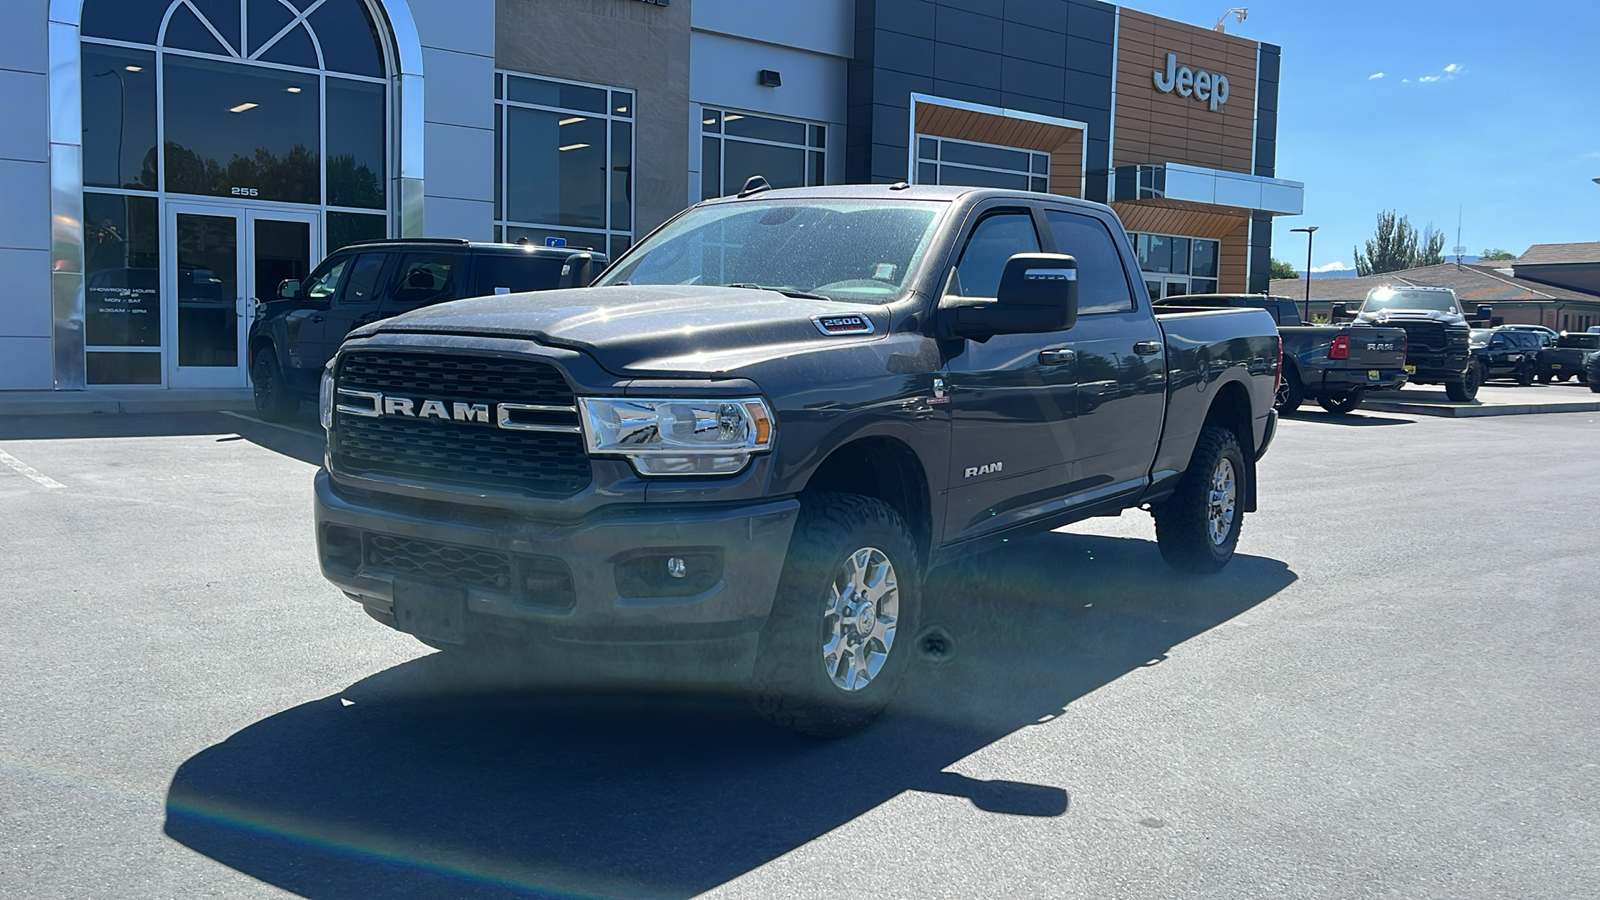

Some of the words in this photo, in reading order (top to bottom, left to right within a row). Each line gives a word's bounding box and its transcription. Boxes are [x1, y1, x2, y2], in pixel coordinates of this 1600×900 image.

[1153, 52, 1230, 112] Jeep
[231, 186, 259, 197] 255
[823, 317, 861, 326] 2500
[384, 396, 490, 423] RAM
[964, 461, 1003, 479] RAM
